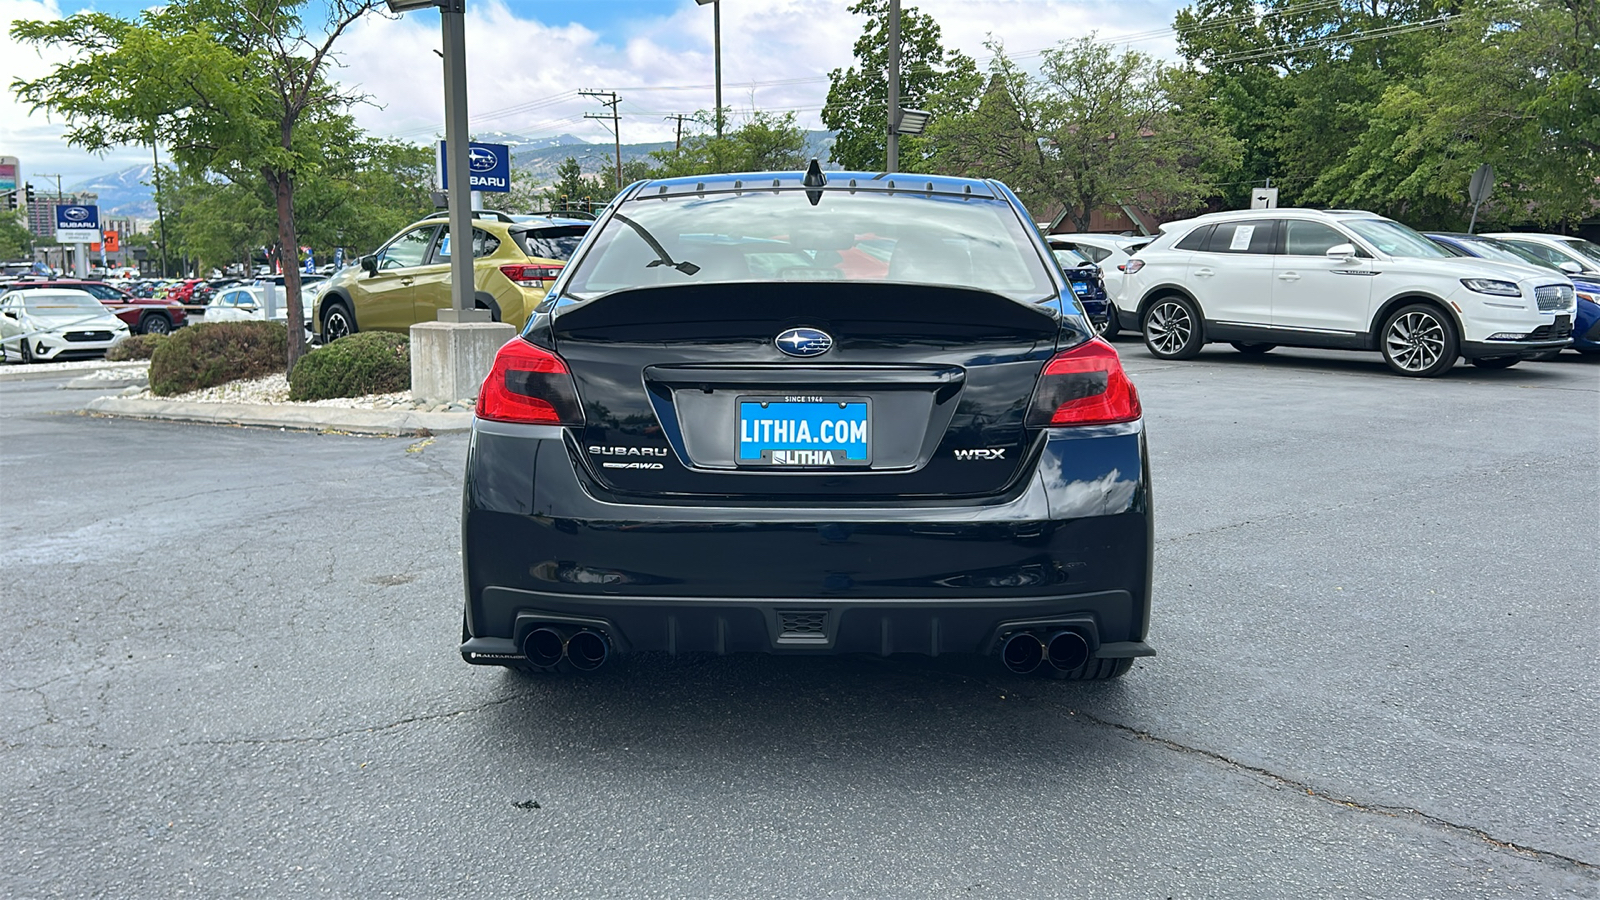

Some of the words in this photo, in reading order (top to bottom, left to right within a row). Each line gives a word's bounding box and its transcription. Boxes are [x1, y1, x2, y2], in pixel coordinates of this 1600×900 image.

[470, 176, 505, 187] BARU
[741, 419, 867, 443] LITHIA.COM
[588, 446, 668, 457] SUBARU
[786, 451, 835, 464] LITHIA
[954, 448, 1006, 460] WRX
